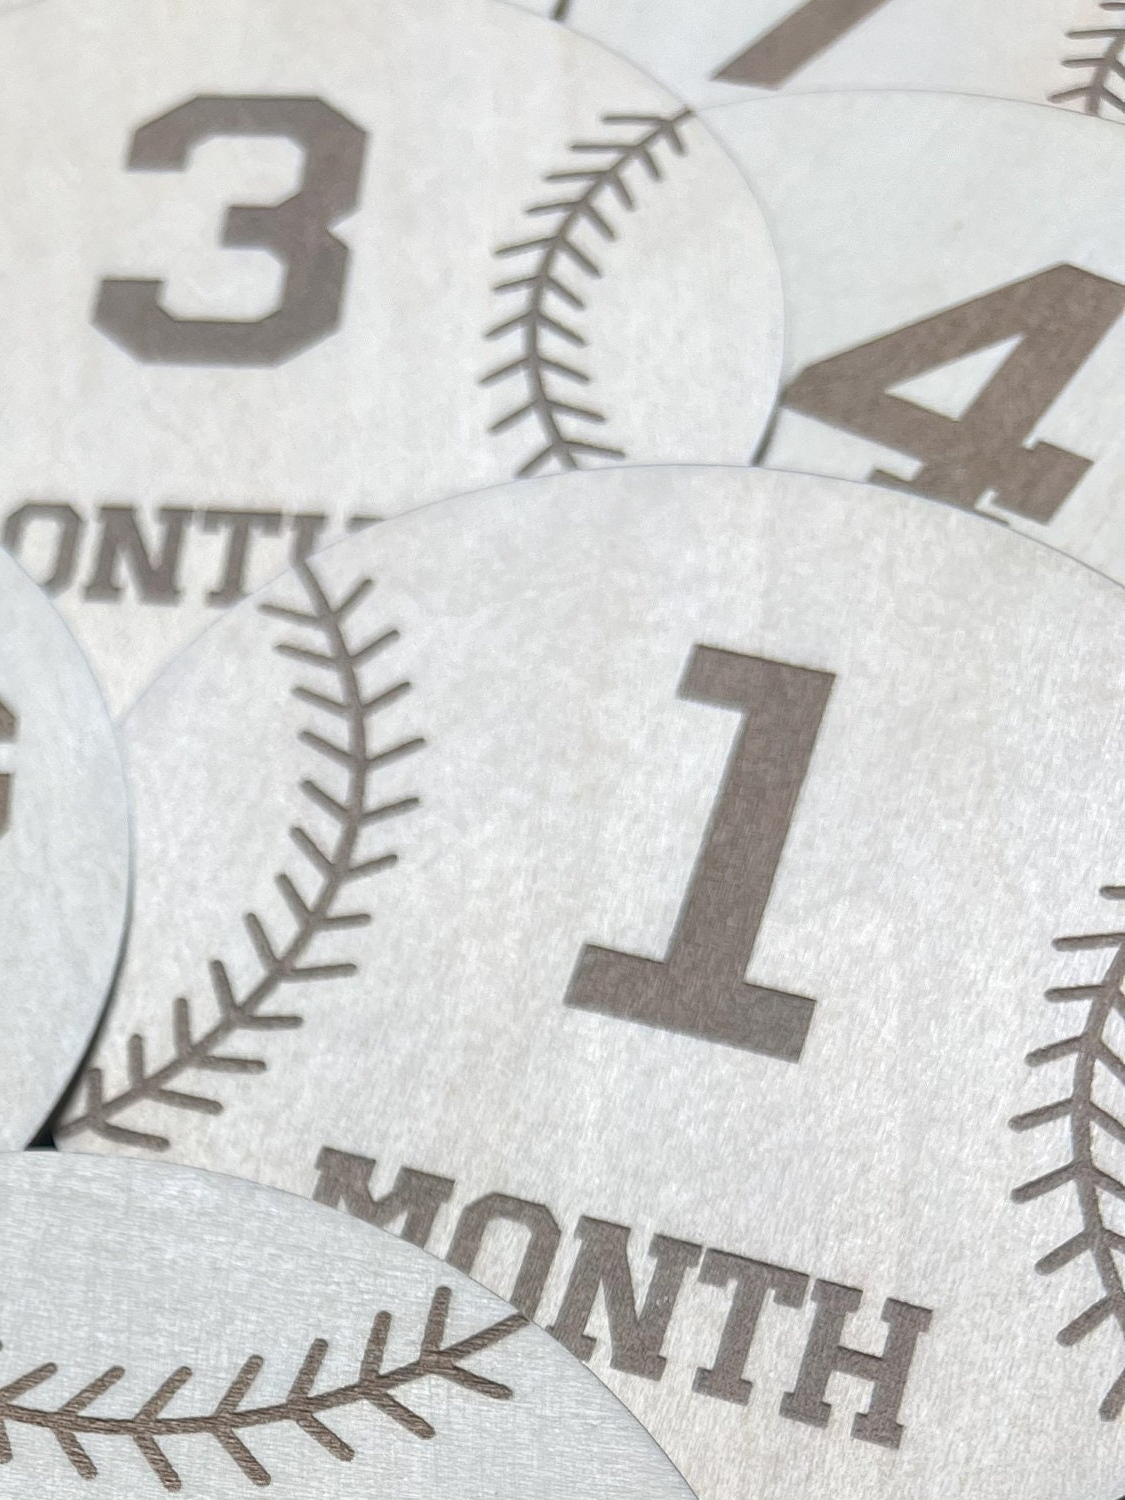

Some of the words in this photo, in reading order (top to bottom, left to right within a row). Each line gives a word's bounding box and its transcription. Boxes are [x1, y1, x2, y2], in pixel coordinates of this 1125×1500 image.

[91, 95, 369, 367] 3
[779, 262, 1125, 526] 4
[564, 644, 836, 1064] 1
